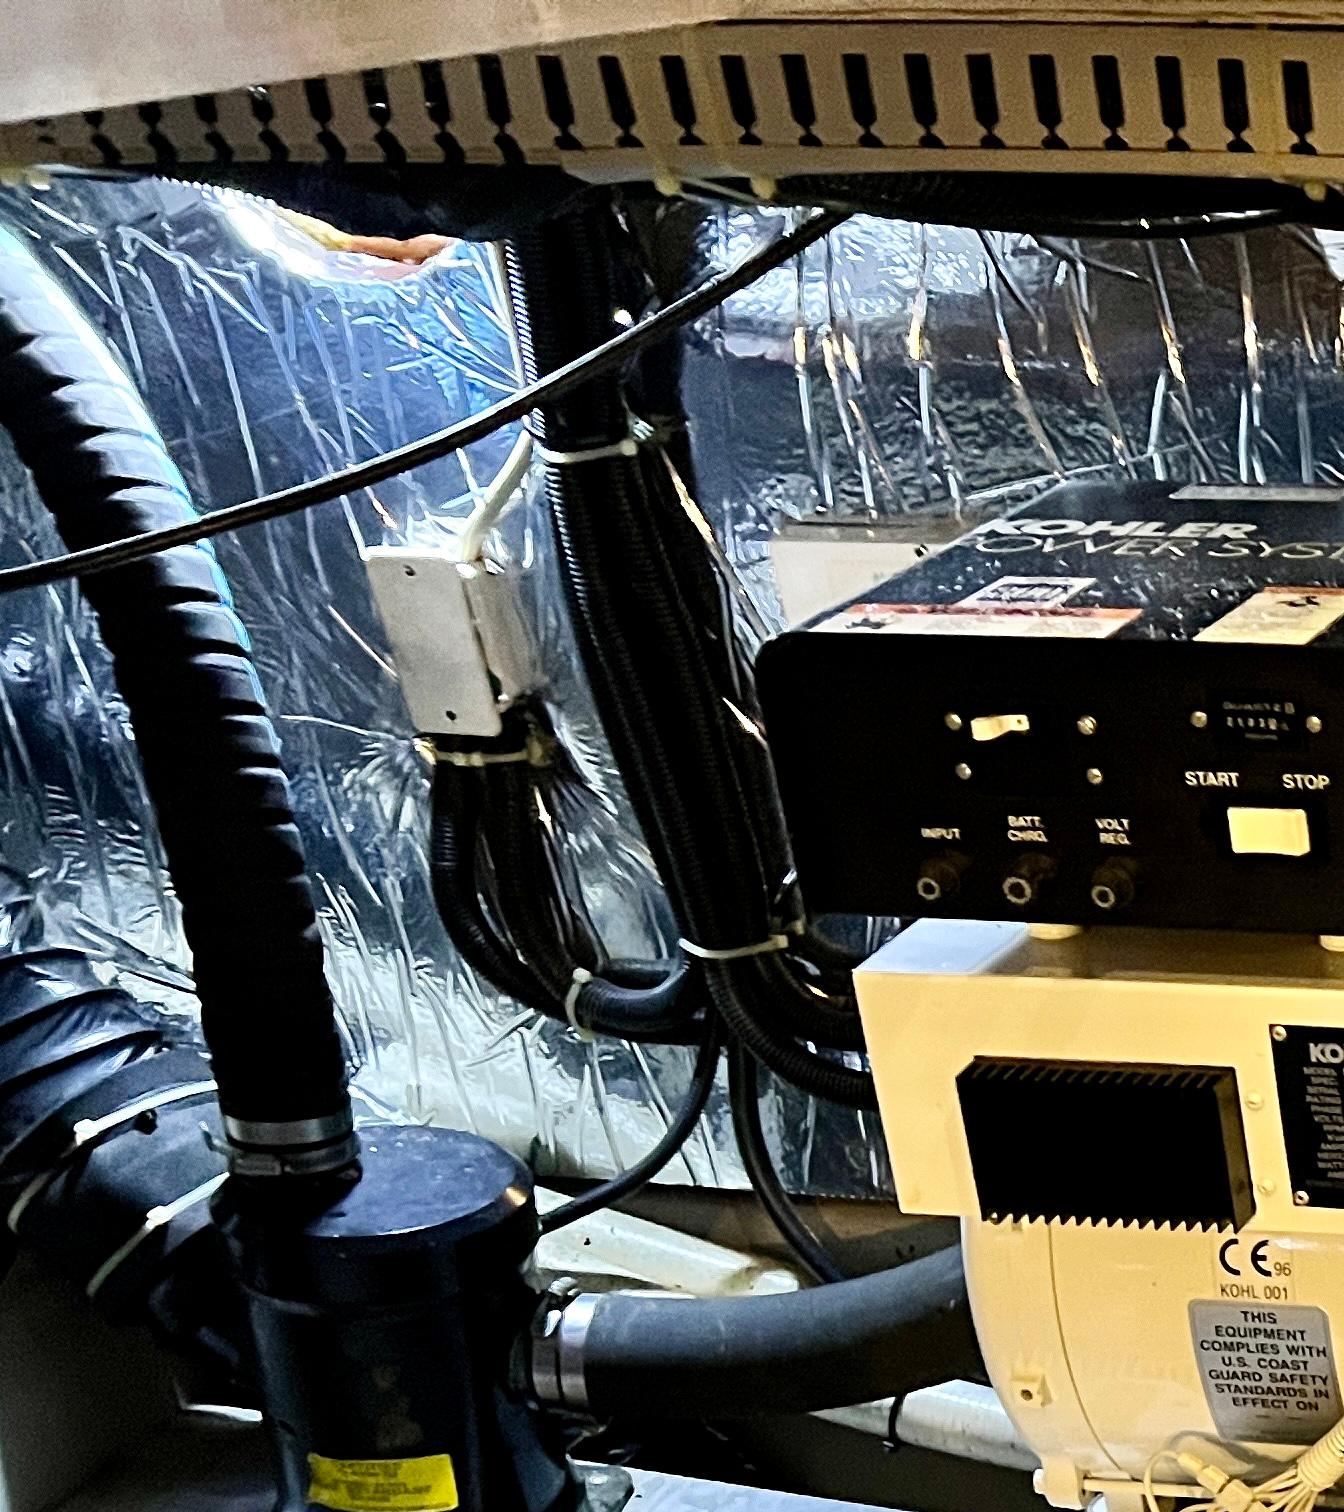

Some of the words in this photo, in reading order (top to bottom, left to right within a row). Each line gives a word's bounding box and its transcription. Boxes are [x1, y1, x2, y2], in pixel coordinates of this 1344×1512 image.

[974, 518, 1258, 539] KOHLER
[1184, 771, 1239, 787] START
[1282, 773, 1330, 790] STOP
[1095, 818, 1130, 831] VOLT
[921, 828, 961, 840] INPUT
[1274, 1262, 1292, 1276] 96
[1220, 1284, 1260, 1299] KOHL
[1264, 1286, 1289, 1300] 001
[1240, 1310, 1277, 1324] THIS
[1214, 1325, 1306, 1342] EQUIPMENT
[1200, 1340, 1280, 1355] COMPLIES
[1286, 1345, 1327, 1358] WITH
[1221, 1357, 1248, 1368] U.S.
[1257, 1358, 1309, 1371] COAST
[1209, 1370, 1263, 1382] GUARD
[1269, 1372, 1329, 1386] SAFETY
[1215, 1384, 1308, 1398] STANDARDS
[1314, 1389, 1330, 1399] IN
[1232, 1397, 1289, 1410] EFFECT
[1296, 1401, 1320, 1412] ON
